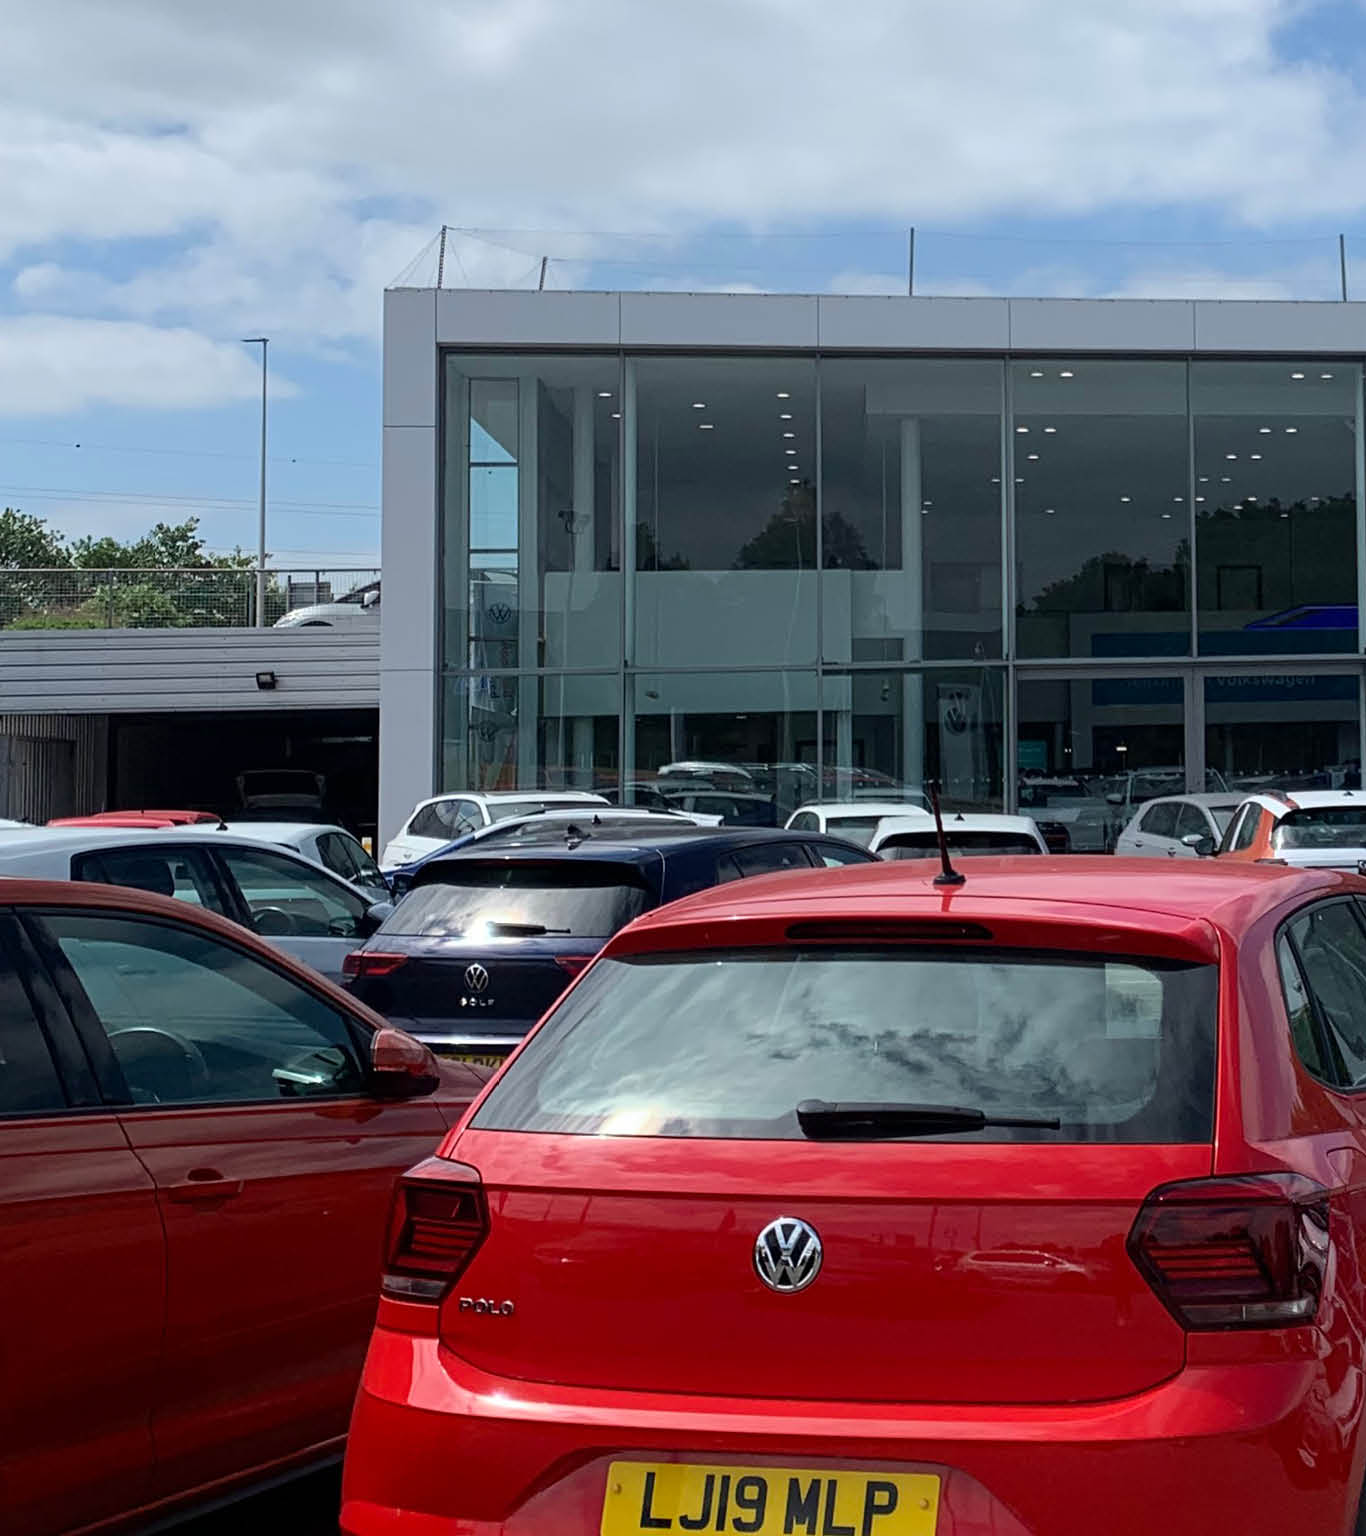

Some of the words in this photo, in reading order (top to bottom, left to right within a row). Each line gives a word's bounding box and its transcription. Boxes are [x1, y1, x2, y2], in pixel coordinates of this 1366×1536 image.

[459, 1297, 515, 1315] POLO
[639, 1472, 769, 1534] LJ19
[783, 1477, 899, 1536] MLP
